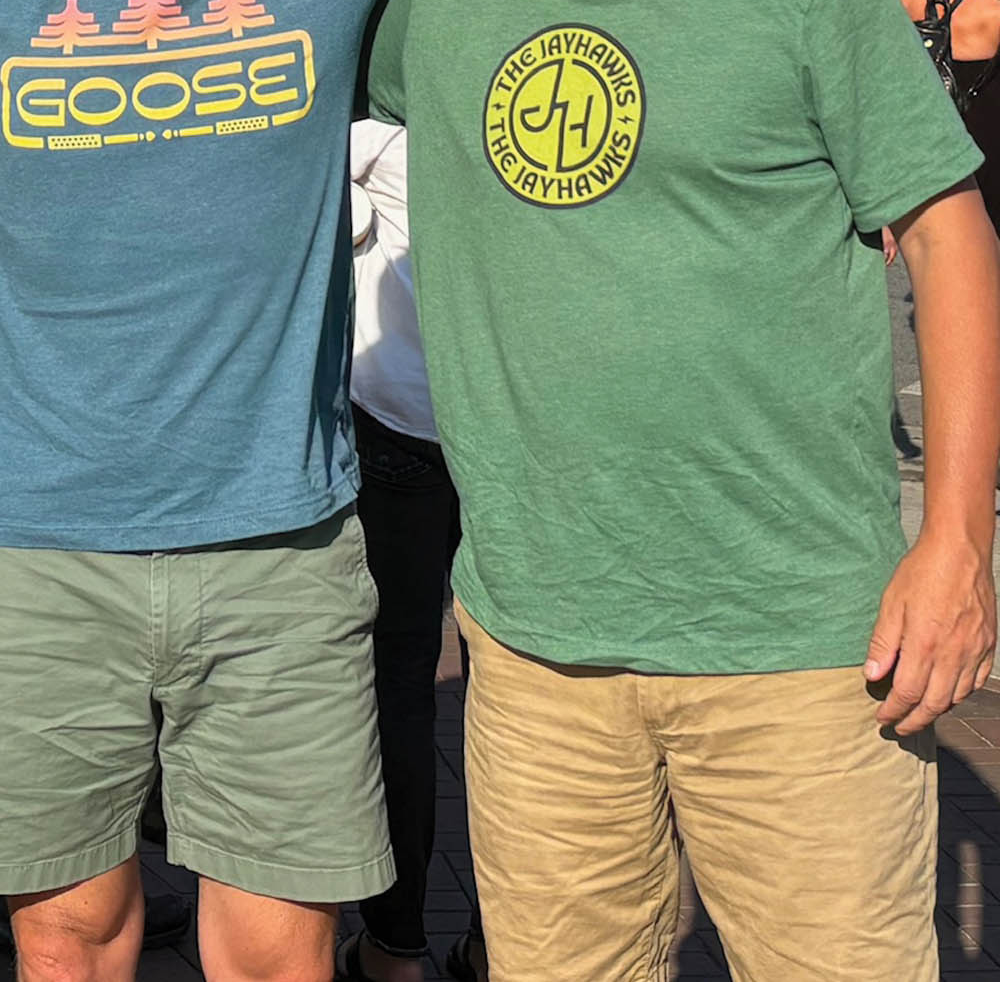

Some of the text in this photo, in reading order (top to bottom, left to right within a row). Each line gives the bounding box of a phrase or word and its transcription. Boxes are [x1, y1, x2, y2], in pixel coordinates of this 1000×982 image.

[15, 51, 299, 127] GOOSE
[495, 32, 637, 108] THE JAYHAWKS
[489, 116, 632, 200] THE JAYHAWKS
